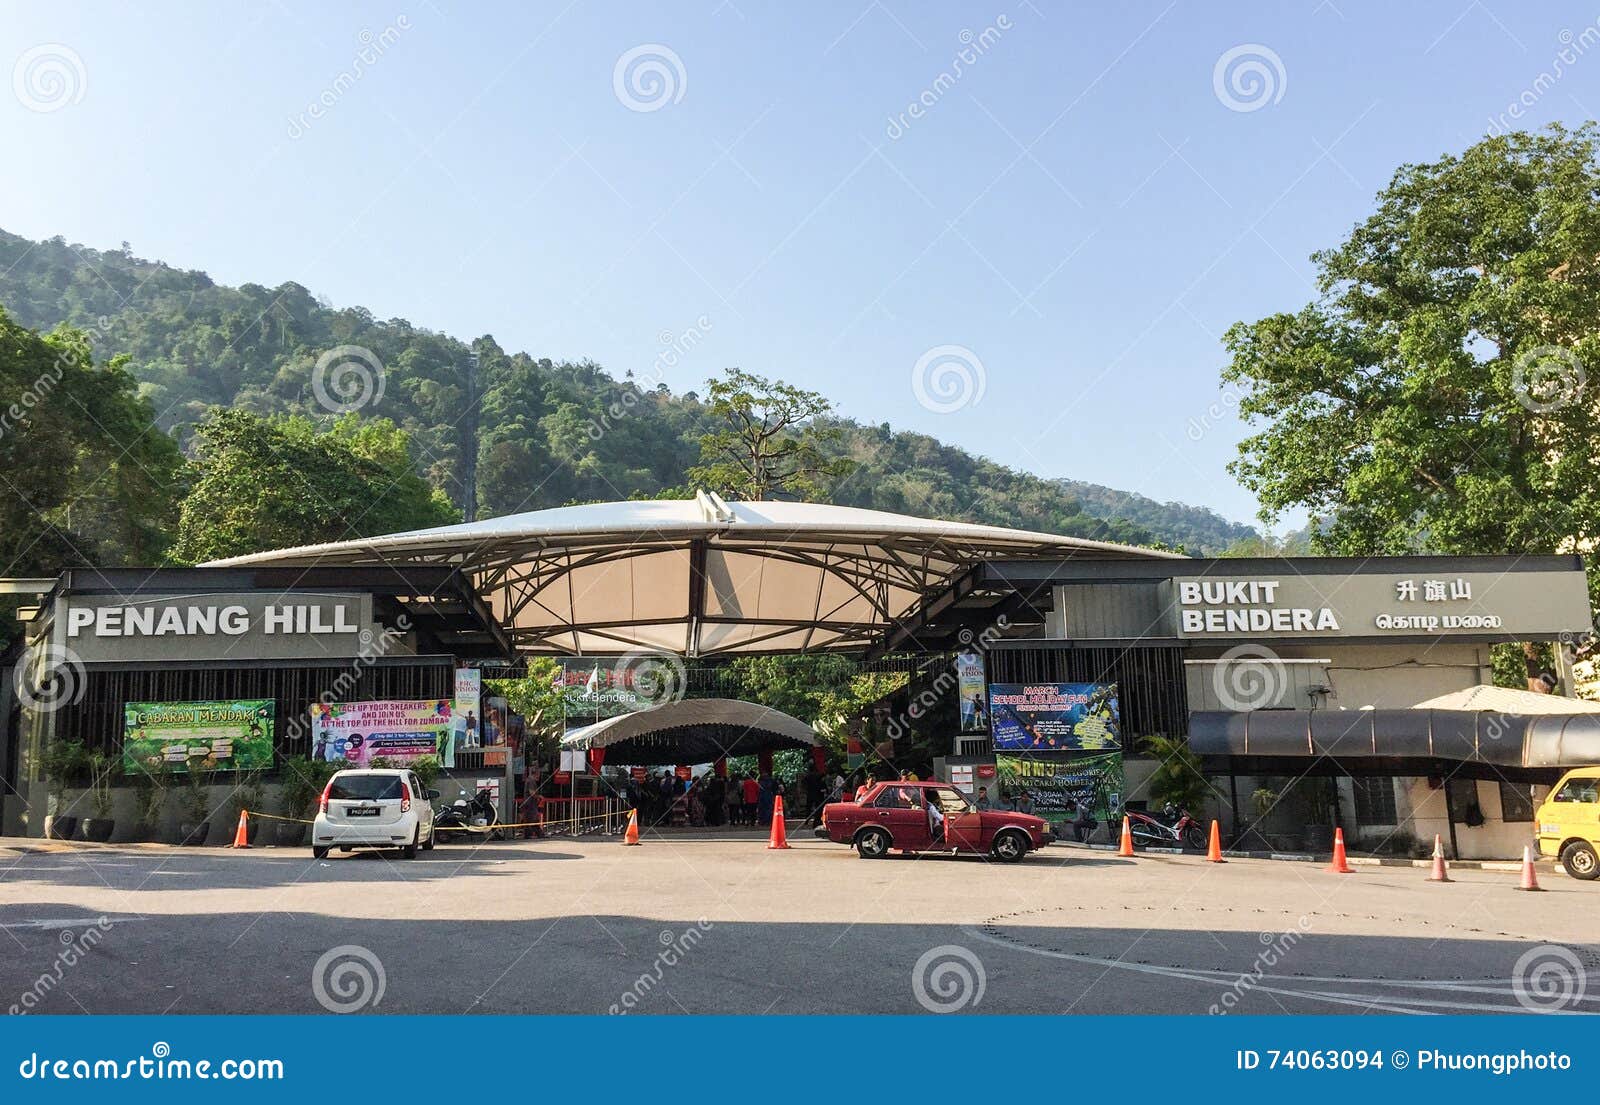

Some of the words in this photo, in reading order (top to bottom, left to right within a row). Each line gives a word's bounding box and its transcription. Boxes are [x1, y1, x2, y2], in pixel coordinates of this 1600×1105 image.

[1180, 581, 1279, 605] BUKIT
[1396, 578, 1472, 601] 升旗山
[67, 605, 249, 637] PENANG
[264, 605, 358, 634] HILL
[1182, 608, 1340, 632] BENDERA
[1024, 686, 1059, 695] MARCH
[592, 692, 636, 702] Bendera
[993, 695, 1029, 705] SCHOOL
[1030, 694, 1068, 704] HOLIDAY
[1069, 694, 1088, 704] FUN
[369, 703, 389, 711] YOUR
[390, 702, 428, 711] SNEAKERS
[138, 711, 195, 724] CABARAN
[199, 709, 256, 721] MENDAKI
[378, 711, 394, 719] JOIN
[321, 719, 331, 728] AT
[332, 719, 346, 728] THE
[347, 719, 360, 728] TOP
[362, 719, 371, 727] OF
[374, 718, 387, 727] THE
[388, 718, 402, 726] HILL
[404, 718, 417, 726] FOR
